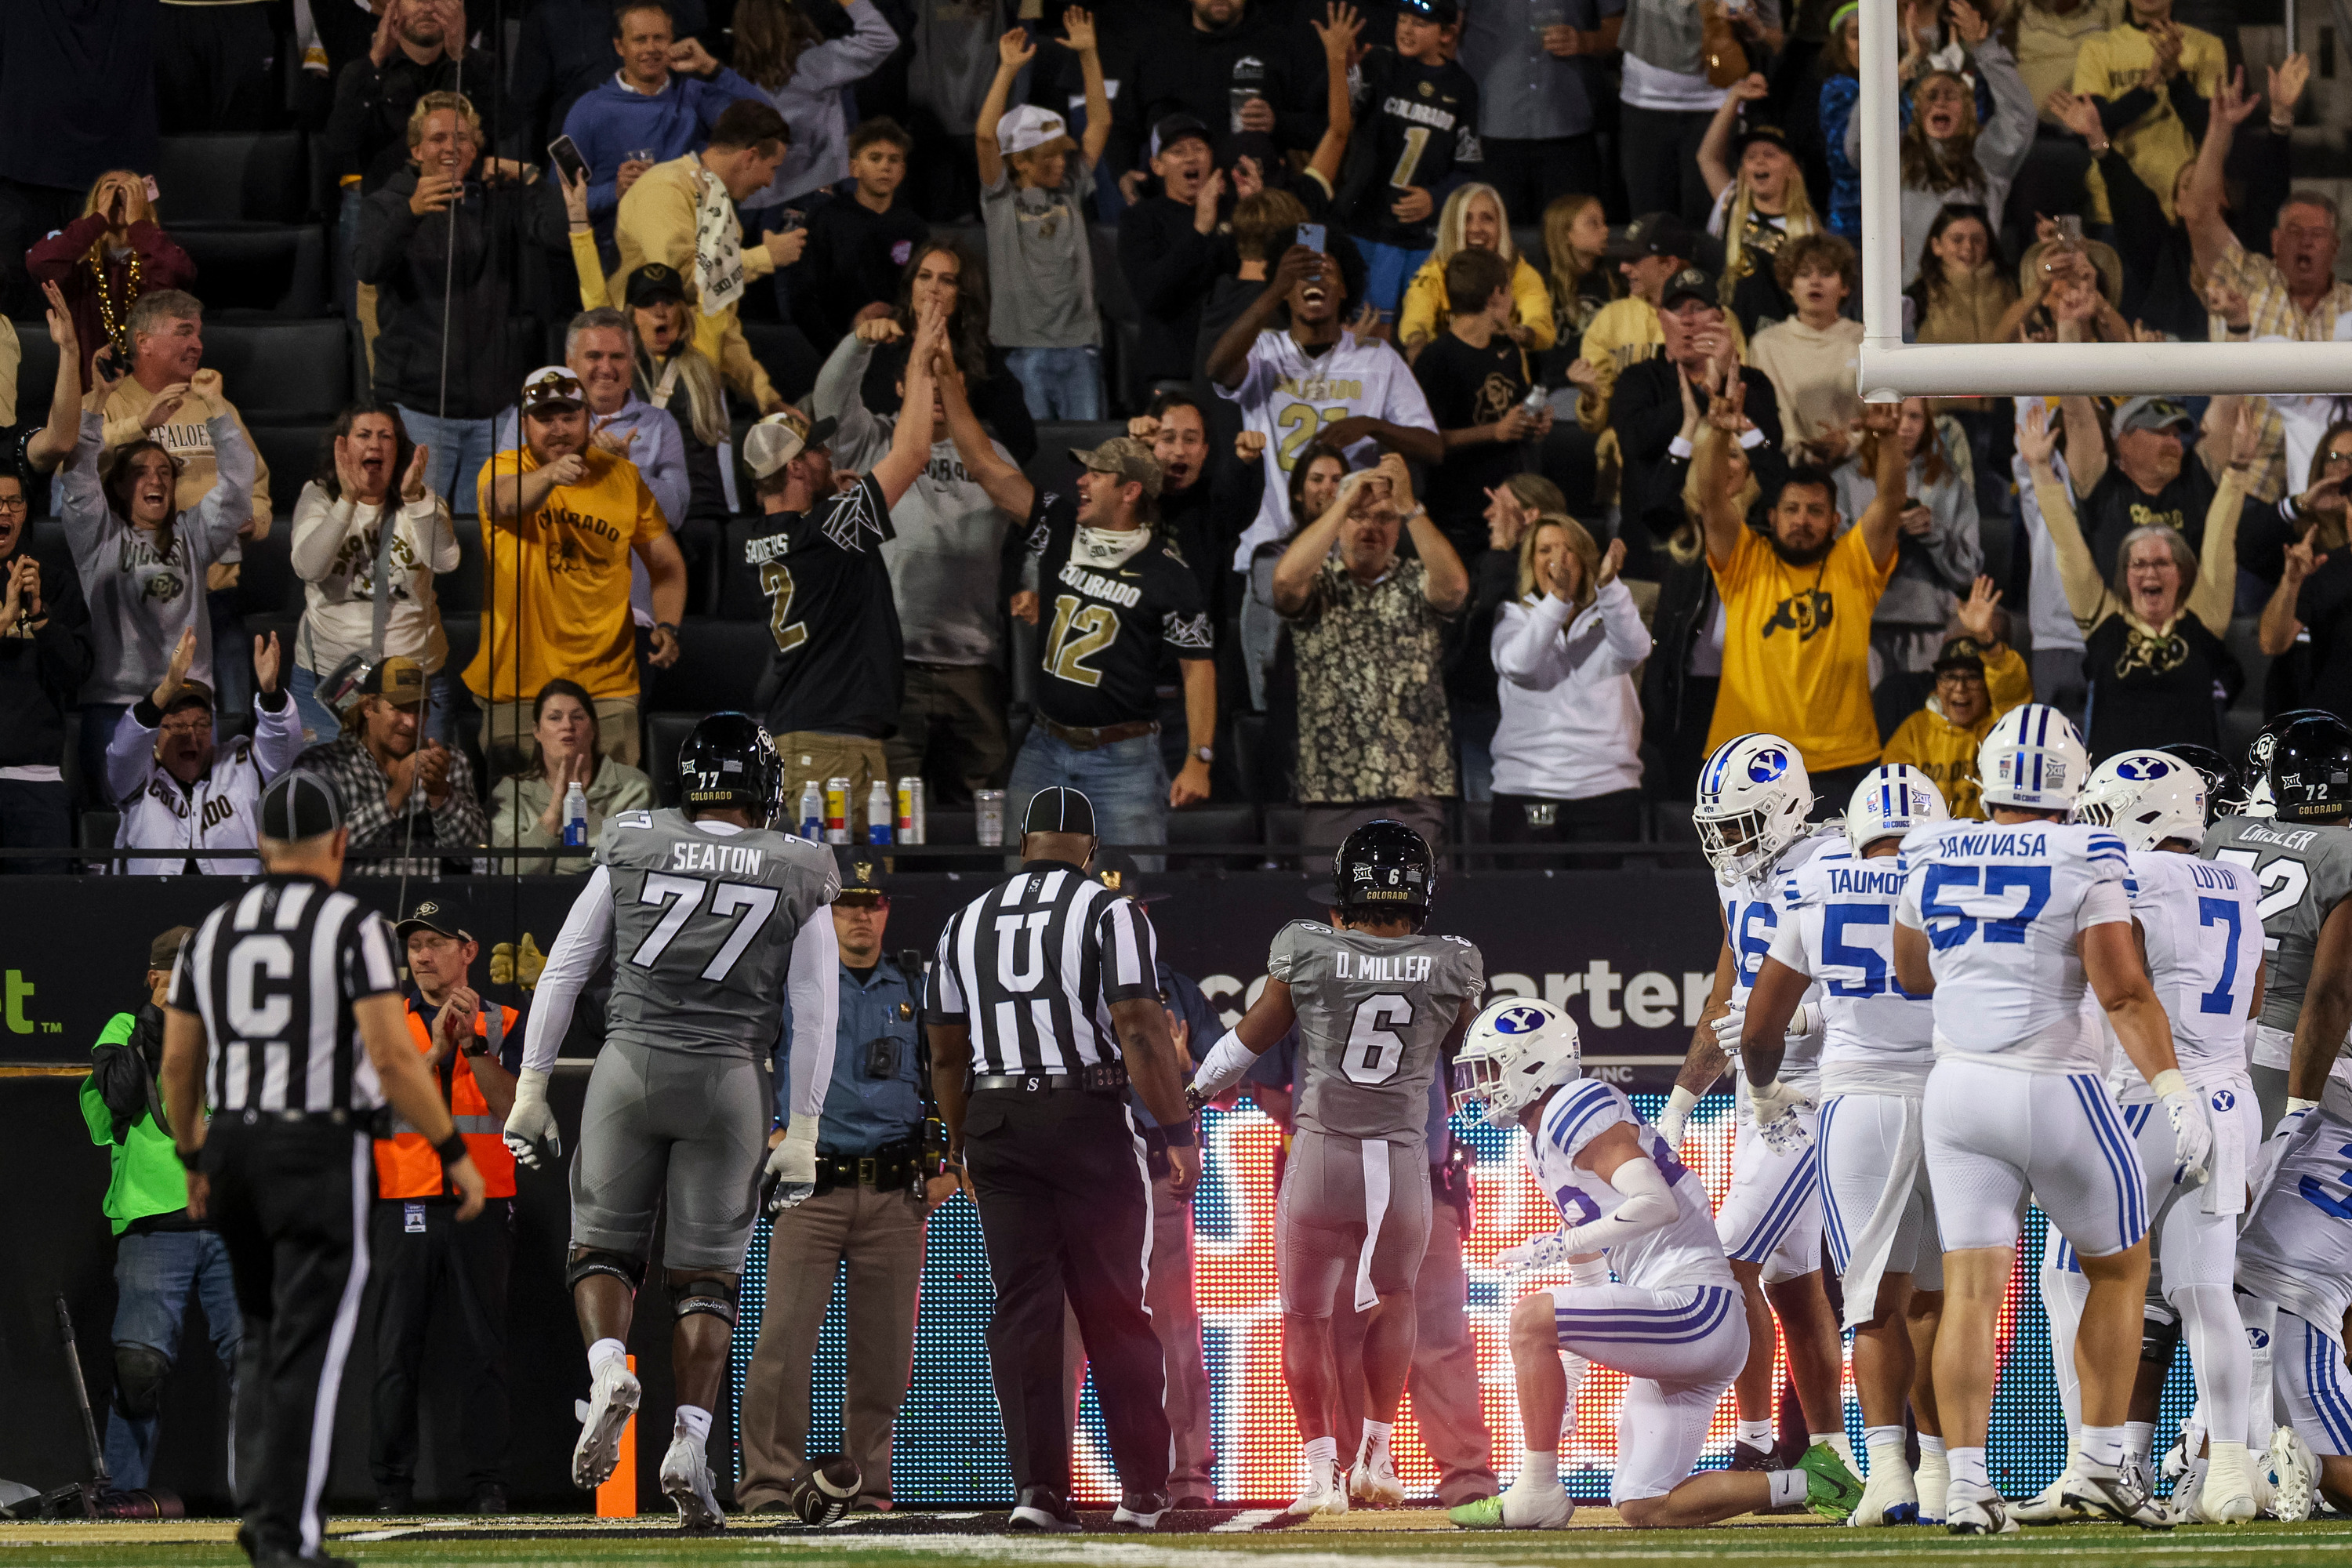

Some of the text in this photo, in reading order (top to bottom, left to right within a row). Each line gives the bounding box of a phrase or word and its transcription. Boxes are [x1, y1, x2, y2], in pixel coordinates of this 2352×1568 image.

[1389, 127, 1432, 188] 1
[149, 424, 208, 448] FALOE
[759, 559, 808, 652] 2
[1042, 595, 1121, 688] 12
[691, 791, 732, 801] COLORADO
[698, 771, 720, 789] 77
[2306, 783, 2328, 800] 72
[1868, 804, 1878, 812] 55
[2299, 804, 2342, 815] COLORADO
[673, 842, 762, 876] SEATON
[1388, 869, 1399, 885] 6
[1367, 891, 1408, 901] COLORADO
[1921, 864, 2052, 951] 57
[628, 869, 782, 982] 77
[994, 909, 1052, 993] U
[1336, 951, 1432, 982] D. MILLER
[2198, 895, 2241, 1014] 7
[0, 969, 62, 1035] t TM
[227, 933, 293, 1038] C
[1338, 991, 1416, 1087] 6
